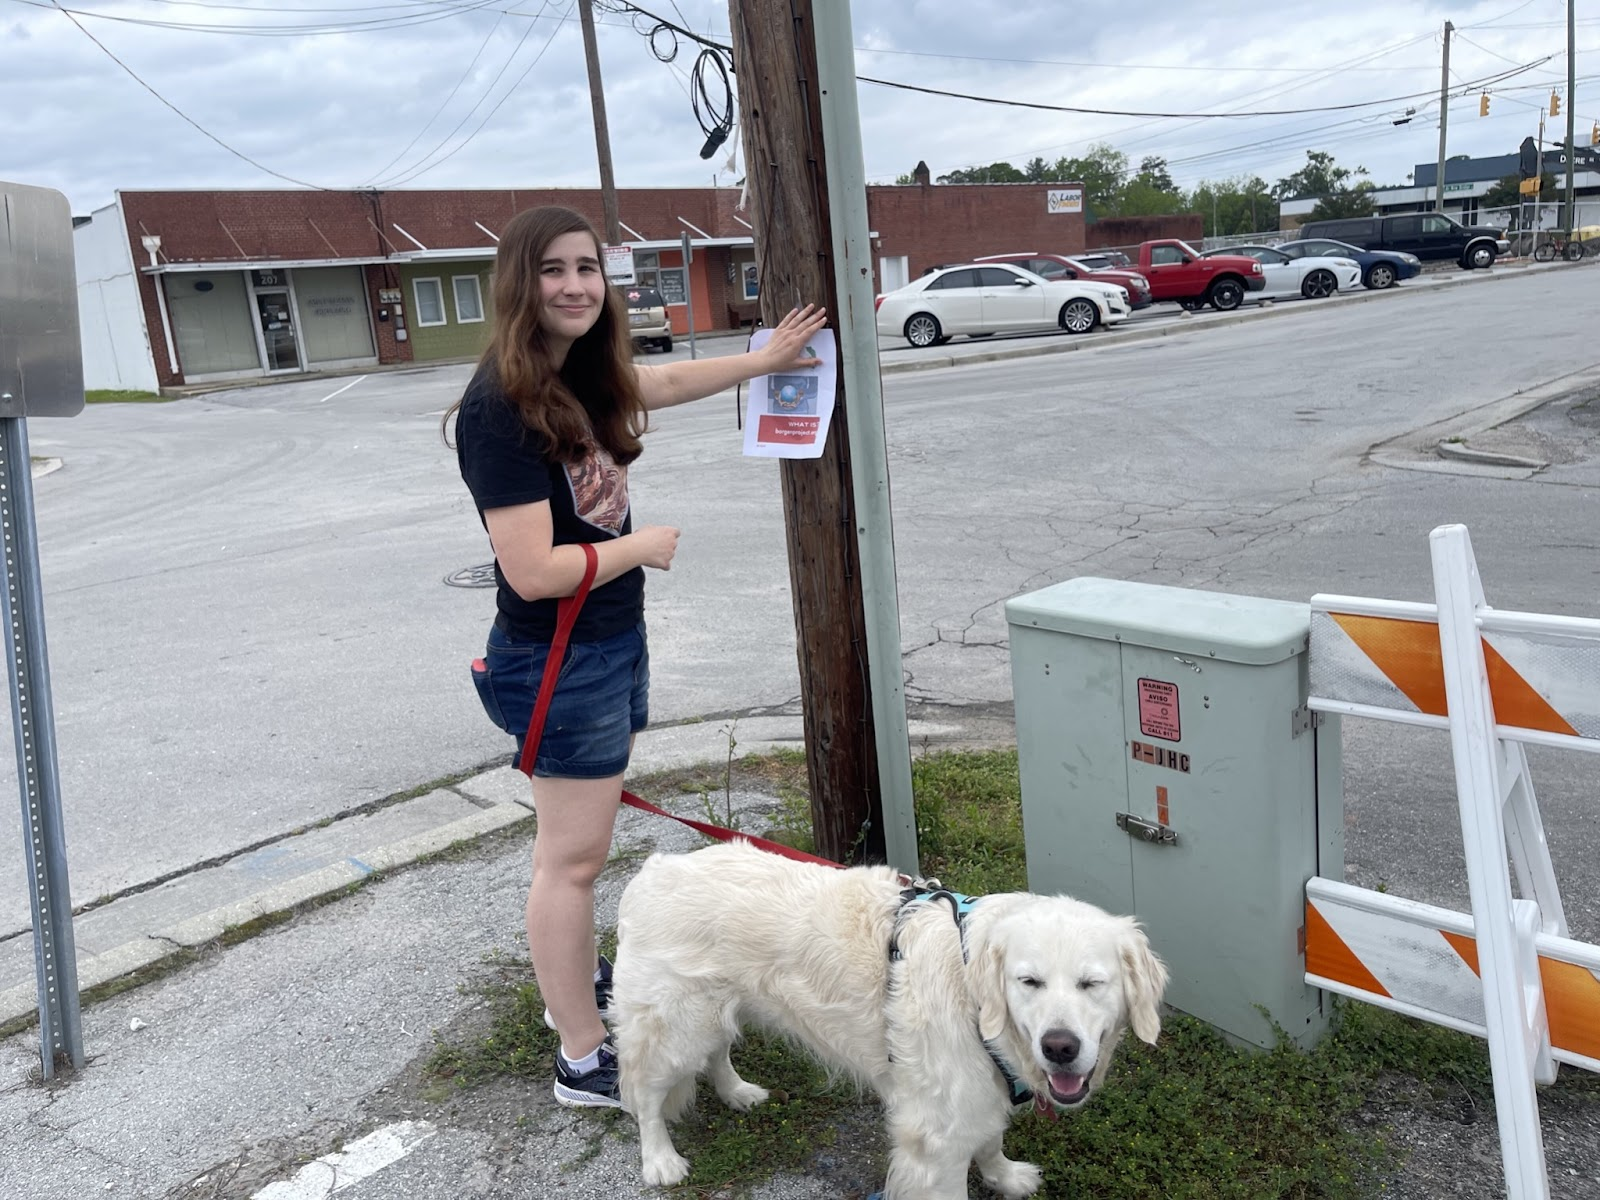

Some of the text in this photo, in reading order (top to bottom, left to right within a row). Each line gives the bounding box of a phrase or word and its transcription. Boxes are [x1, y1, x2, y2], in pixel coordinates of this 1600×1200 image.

[1142, 682, 1173, 692] WARNING
[1148, 694, 1168, 702] AVISO
[1147, 727, 1162, 735] CALL
[1133, 742, 1189, 771] P-JHC
